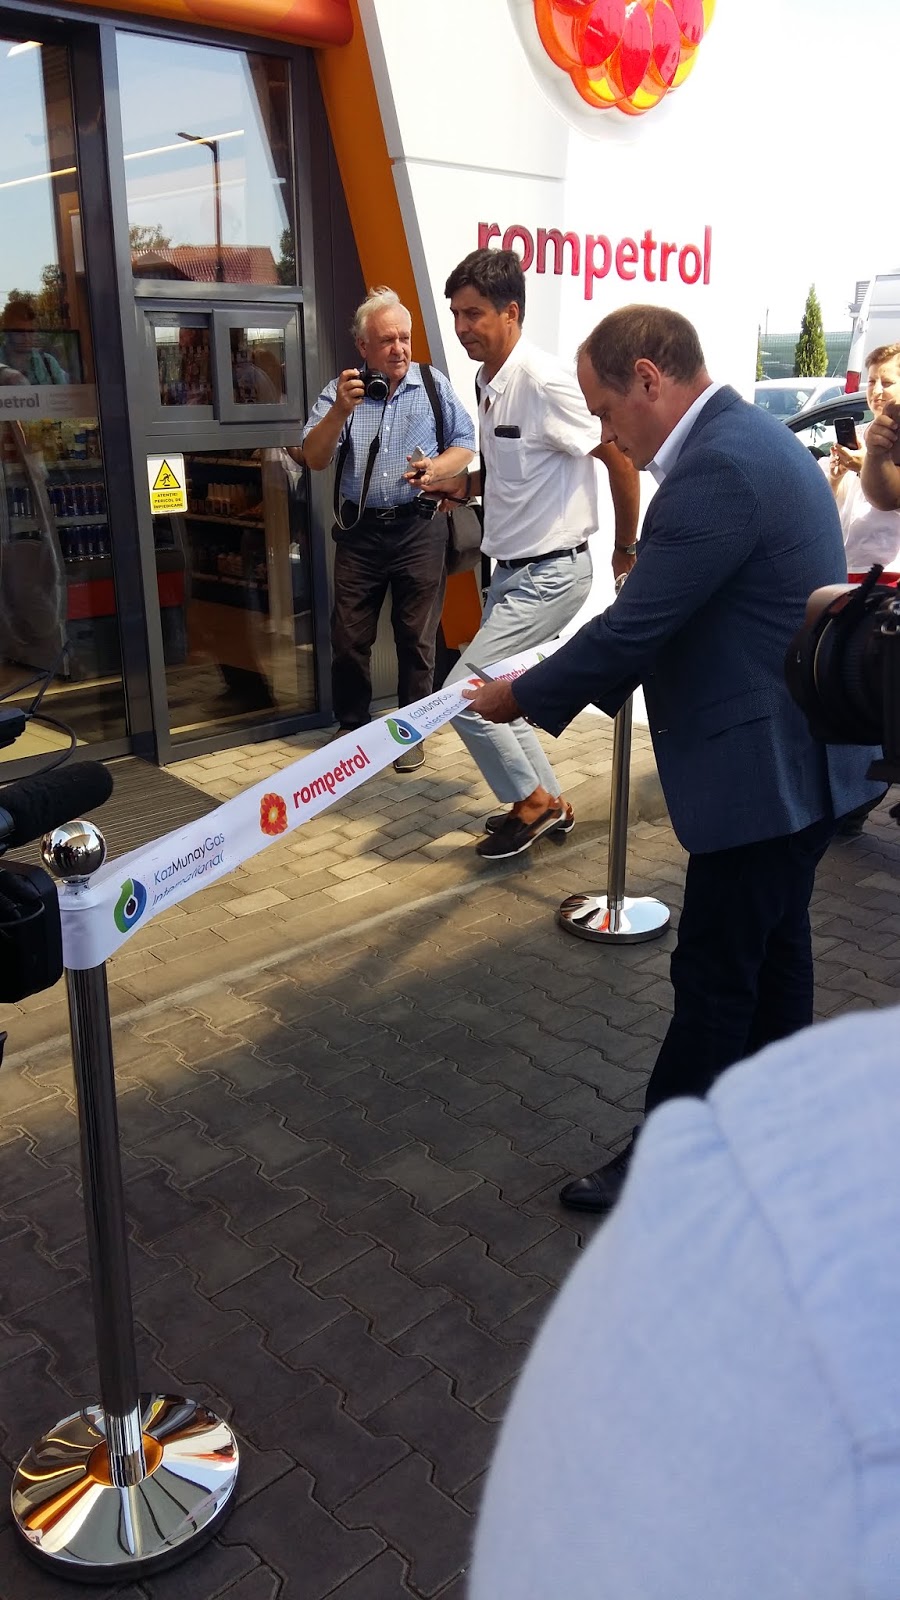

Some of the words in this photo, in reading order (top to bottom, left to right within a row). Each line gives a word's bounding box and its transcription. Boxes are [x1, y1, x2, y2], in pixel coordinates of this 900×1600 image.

[478, 222, 712, 300] rompetrol
[292, 745, 371, 809] rompetrol
[153, 832, 225, 885] KazMunayGas
